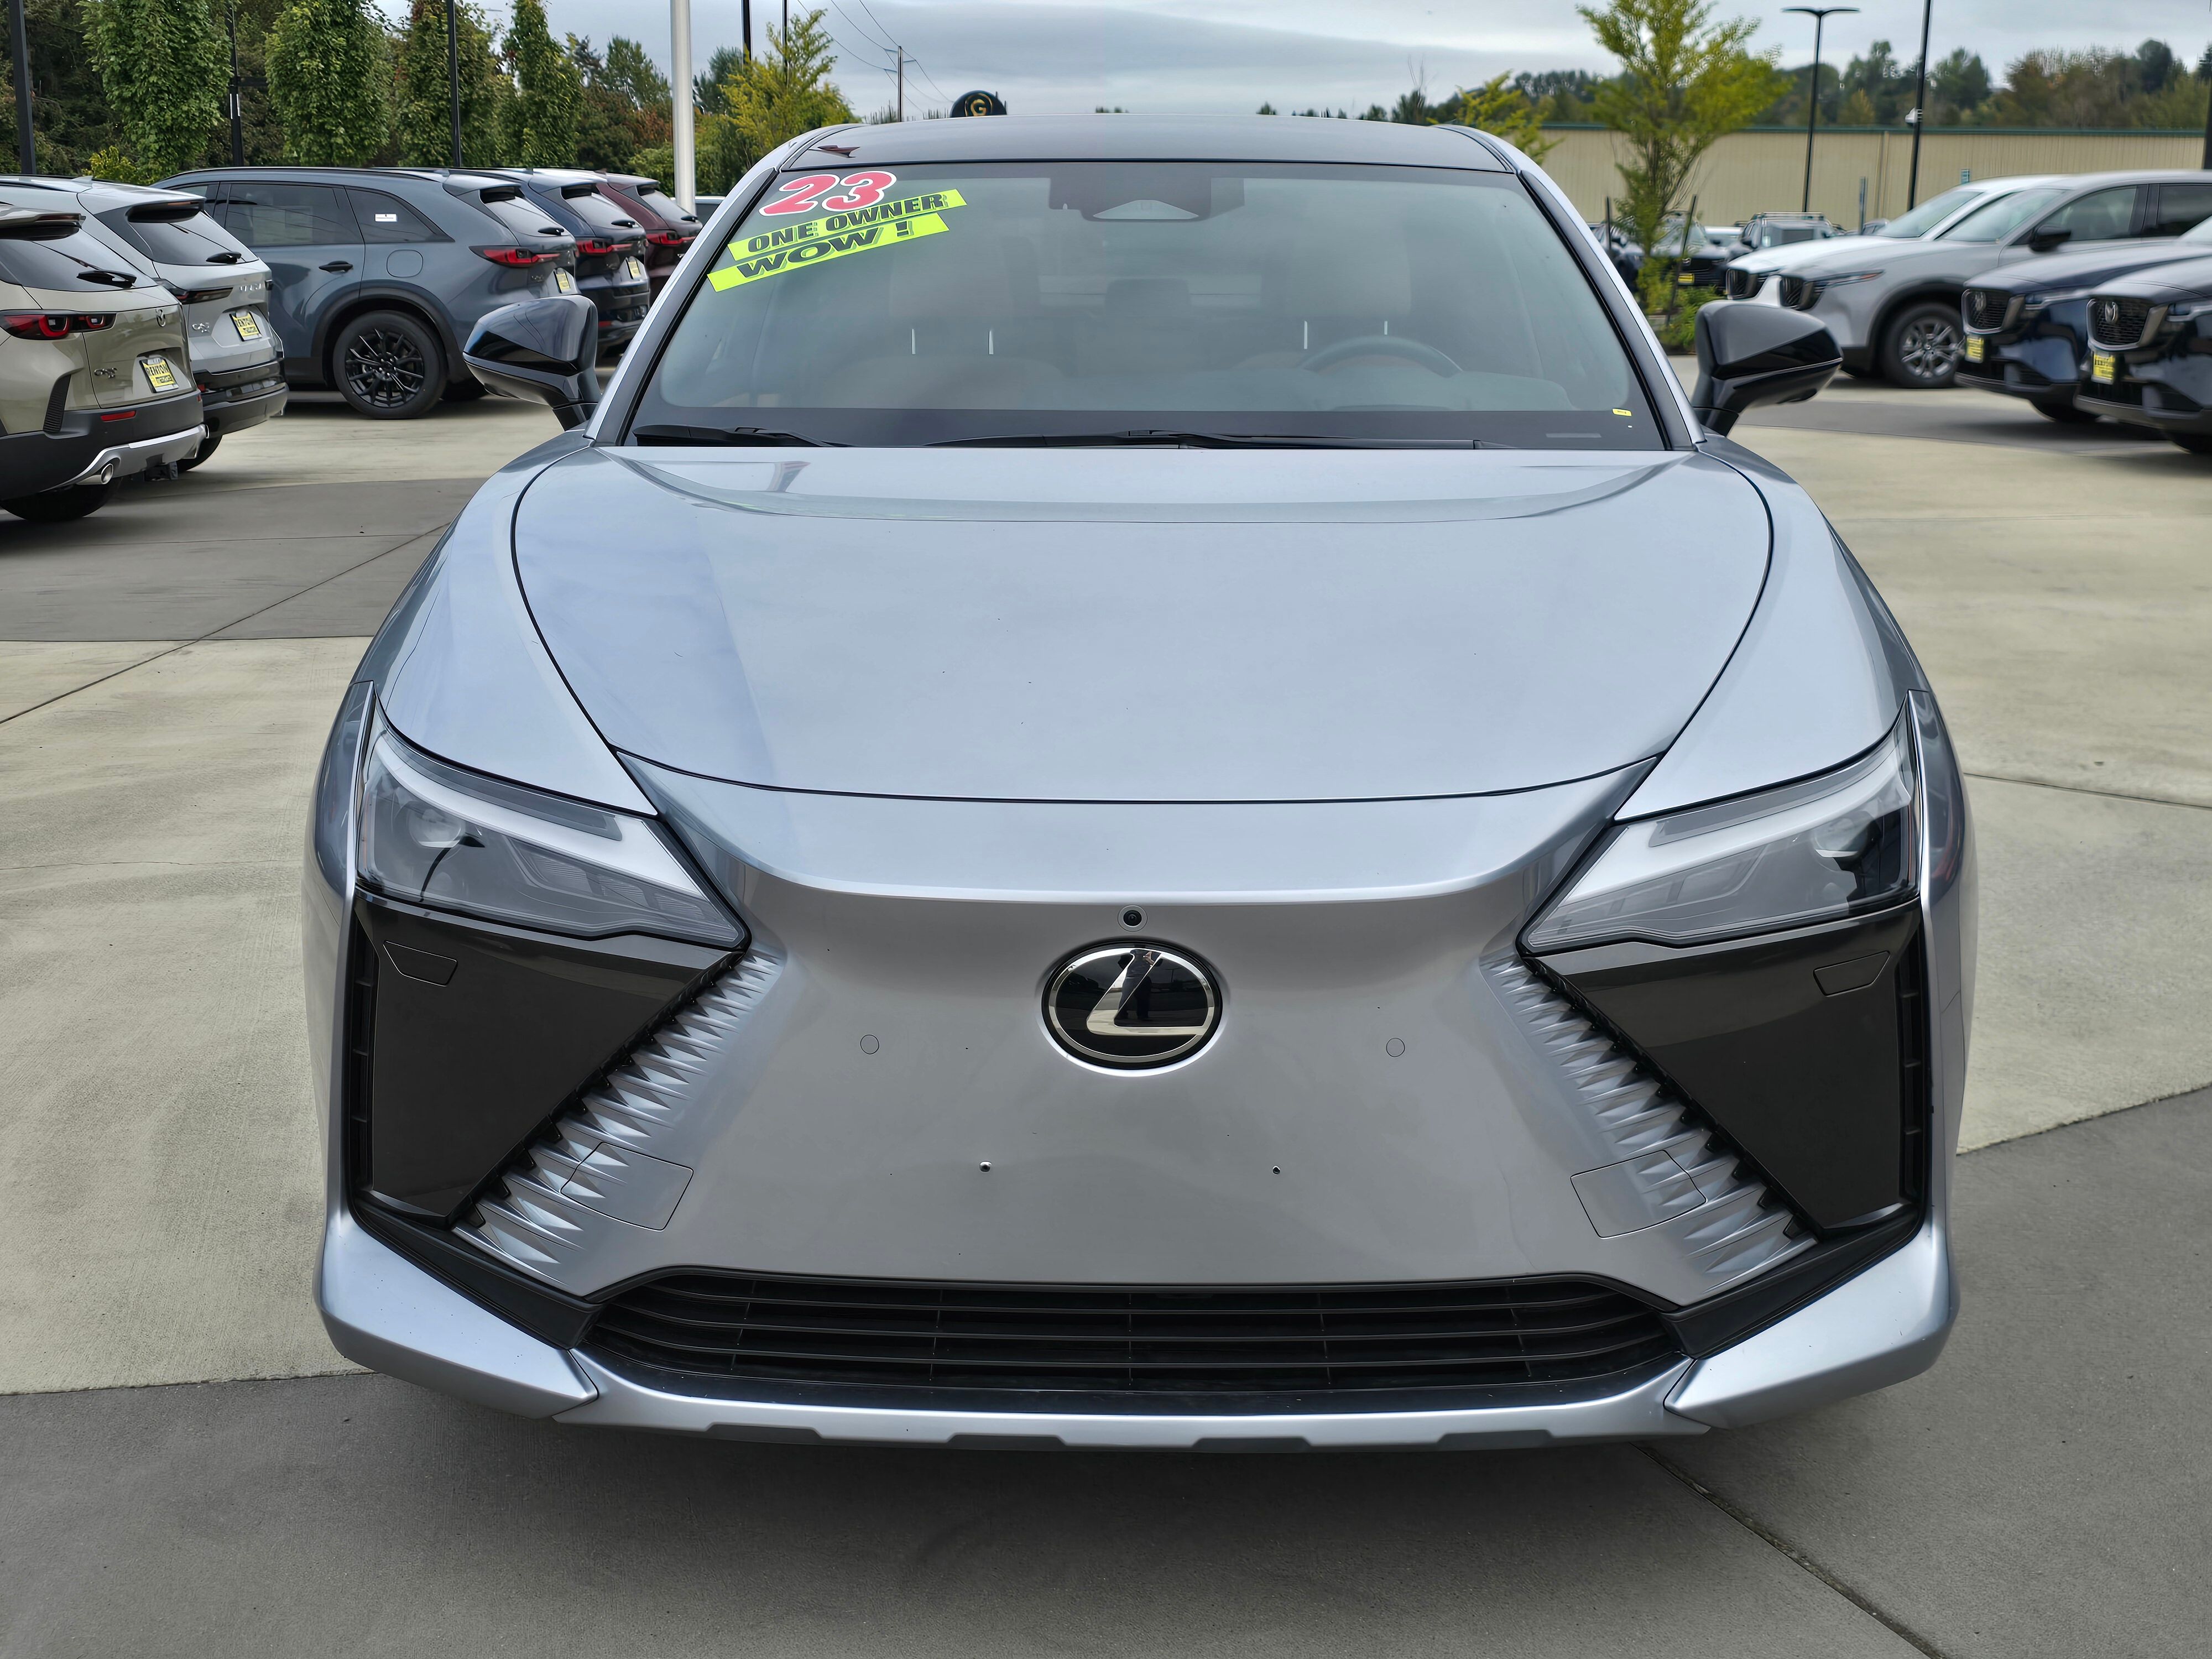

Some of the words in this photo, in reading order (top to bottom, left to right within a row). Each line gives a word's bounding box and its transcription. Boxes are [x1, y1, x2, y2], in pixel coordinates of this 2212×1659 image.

[758, 170, 897, 216] 23
[748, 222, 818, 253] ONE
[826, 194, 949, 232] OWNER
[737, 227, 883, 279] WOW
